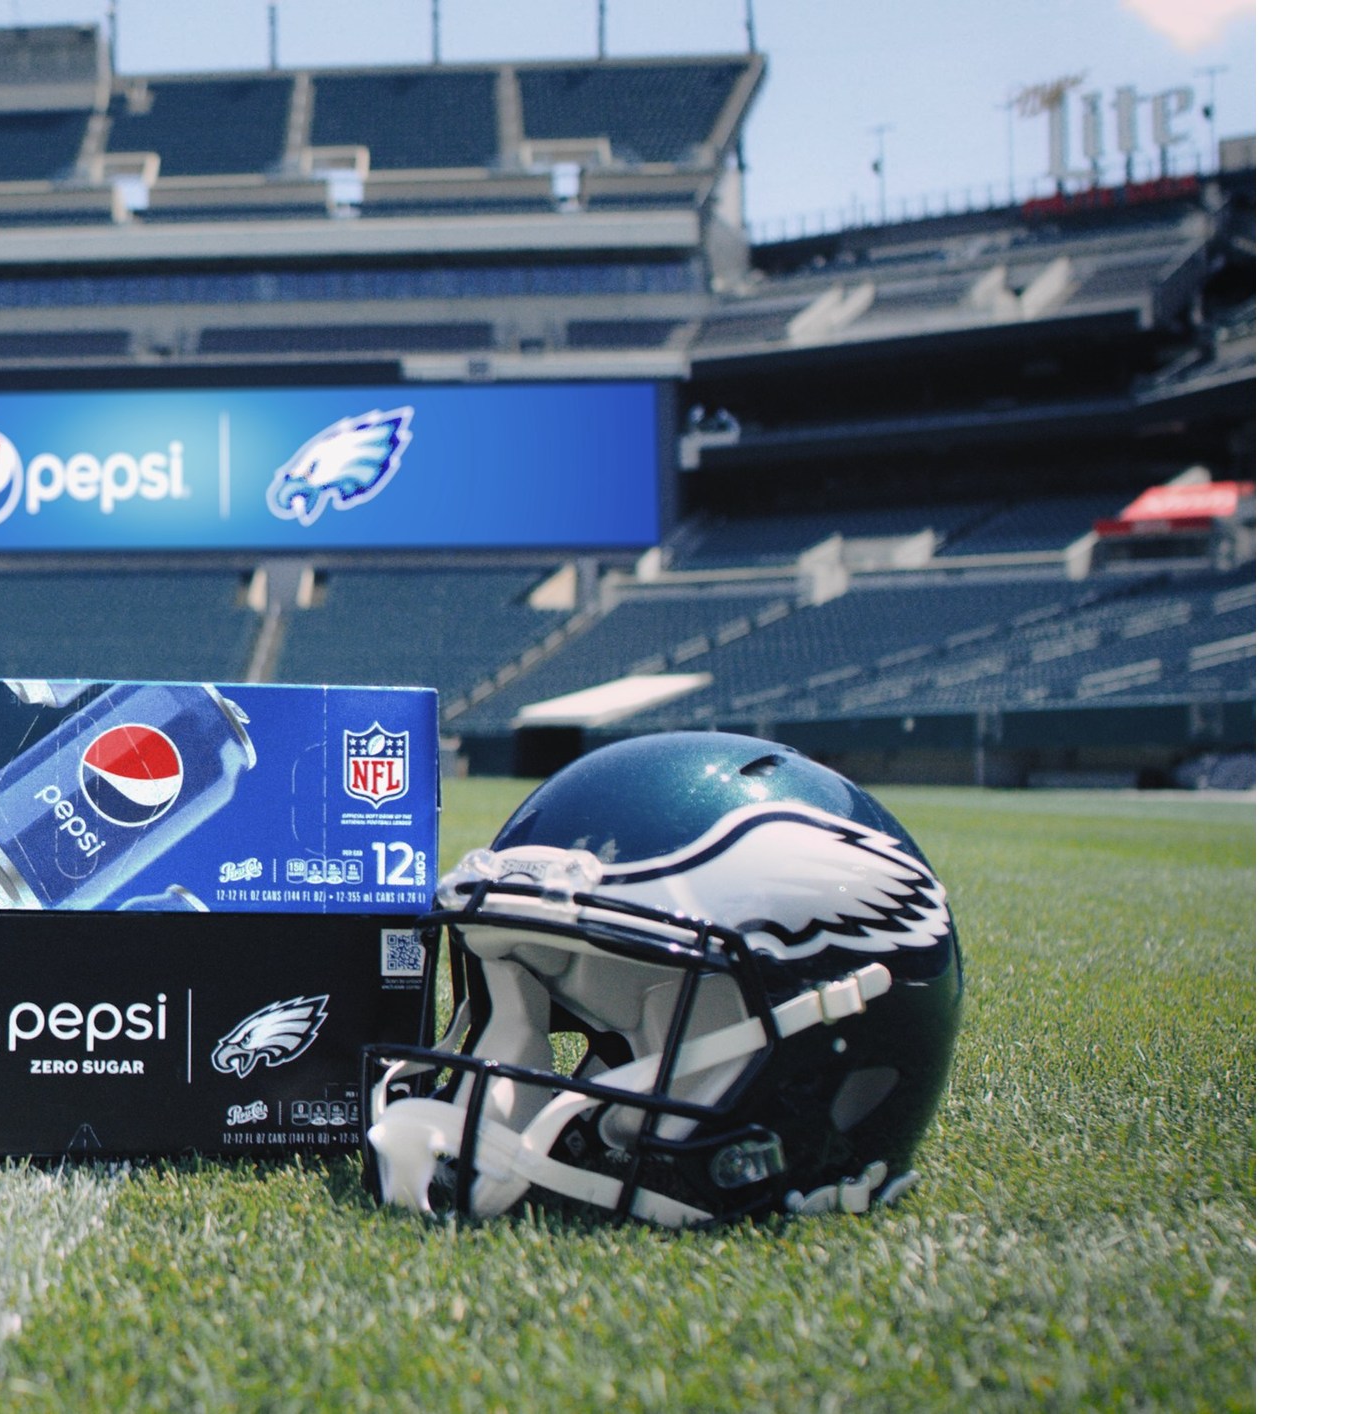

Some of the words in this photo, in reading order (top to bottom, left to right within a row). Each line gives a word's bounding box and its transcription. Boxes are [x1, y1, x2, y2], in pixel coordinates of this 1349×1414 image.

[25, 440, 184, 515] pepsi
[352, 760, 400, 795] NFL
[34, 785, 107, 858] pepsi
[371, 841, 415, 886] 12
[415, 851, 426, 887] cans
[239, 890, 249, 901] FL
[250, 890, 260, 901] OZ
[262, 890, 282, 902] CANS
[303, 891, 312, 902] FL
[376, 892, 395, 903] CANS
[8, 993, 167, 1052] pepsi
[30, 1059, 79, 1075] ZERO
[82, 1059, 145, 1075] SUGAR
[339, 1133, 359, 1144] 12-35
